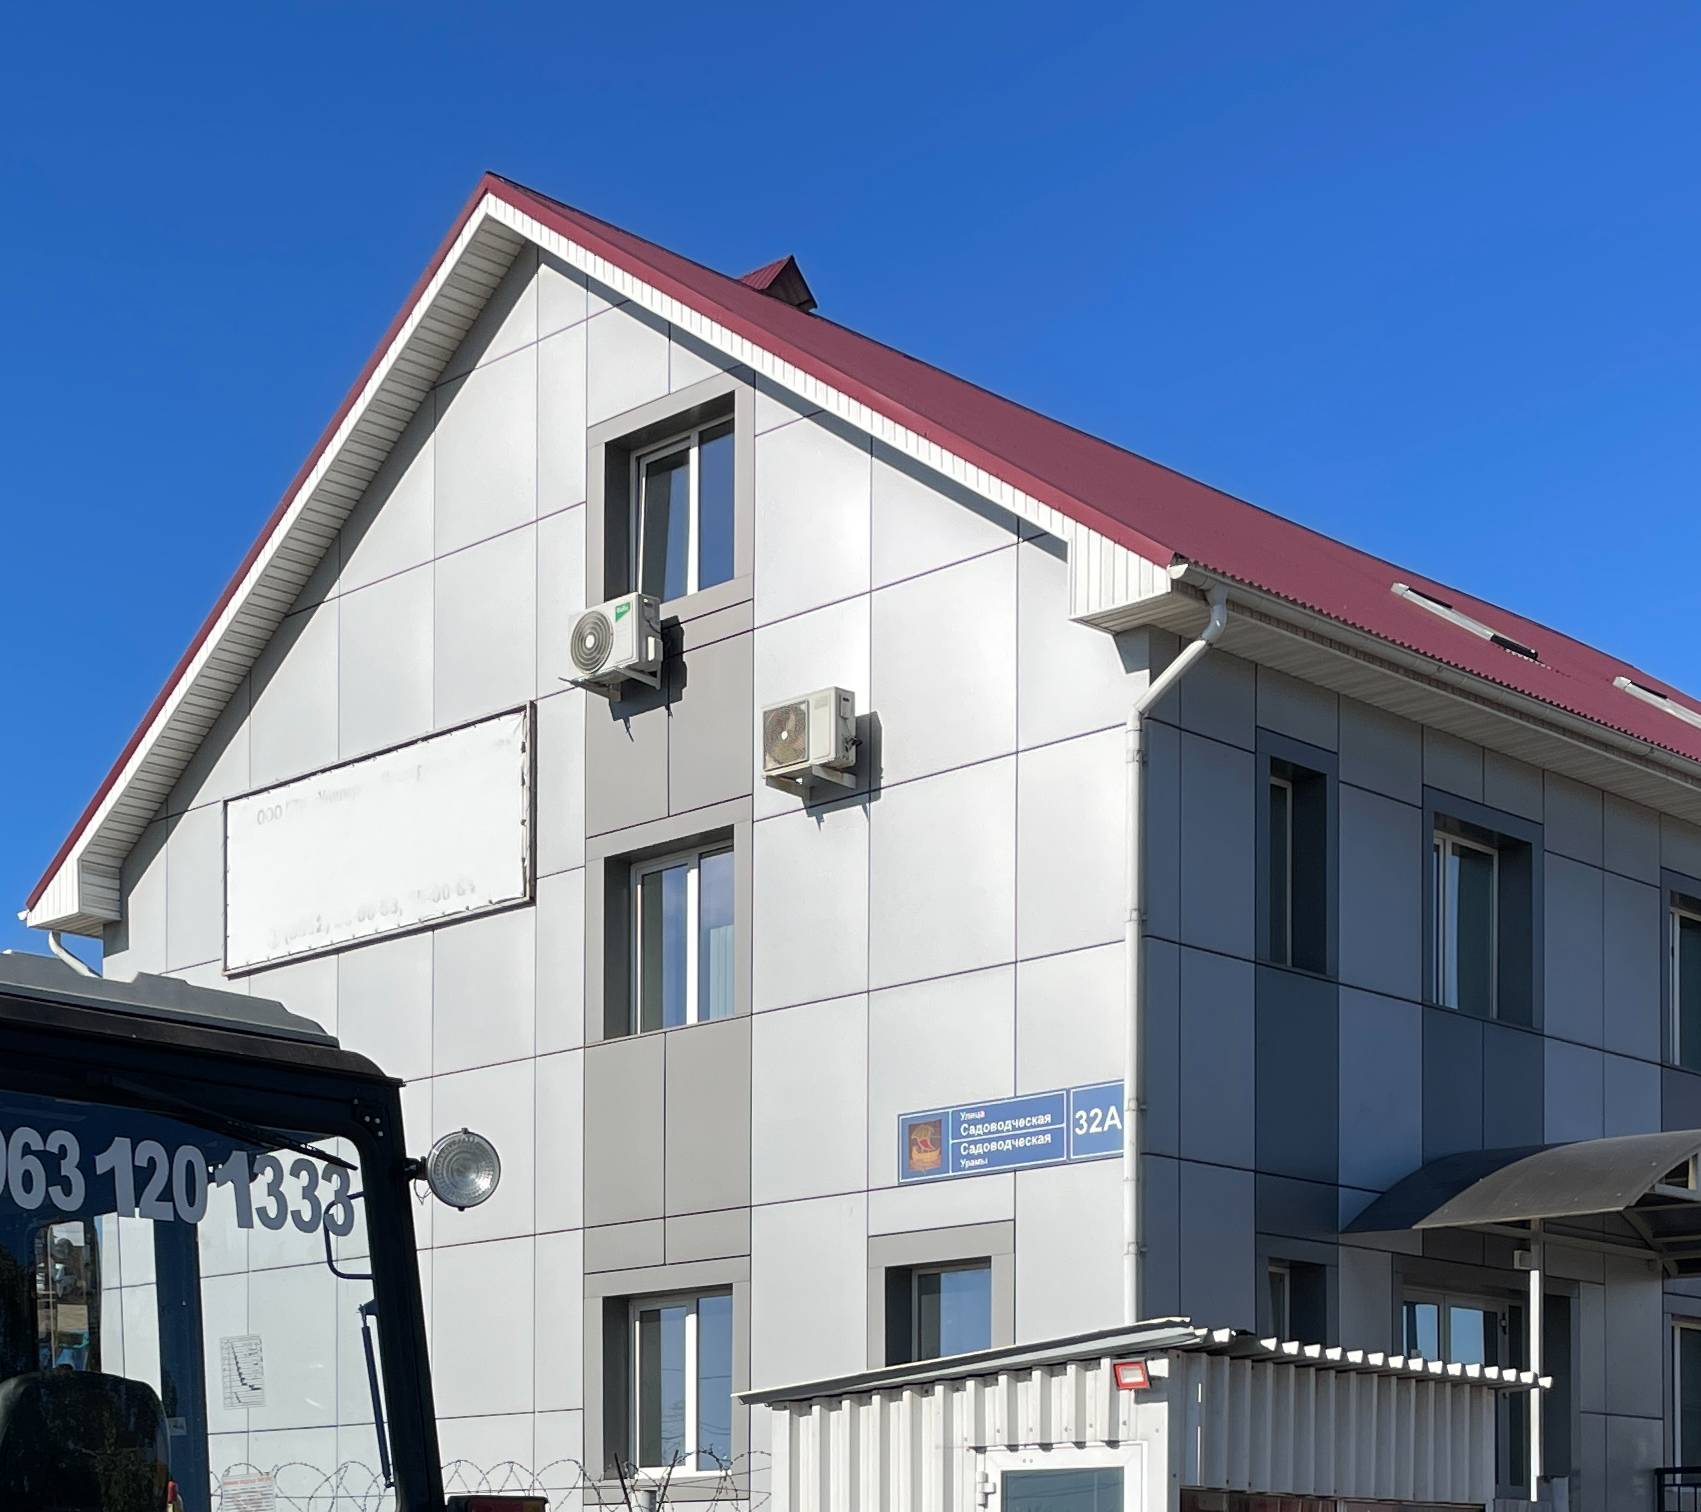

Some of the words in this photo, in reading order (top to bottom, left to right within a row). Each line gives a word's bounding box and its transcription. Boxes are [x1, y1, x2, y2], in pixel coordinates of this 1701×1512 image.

[960, 1110, 986, 1121] Улица
[960, 1113, 1052, 1136] Садоводческая
[1074, 1105, 1123, 1136] 32А
[960, 1133, 1052, 1156] Садоводческая
[95, 1136, 209, 1225] 120
[214, 1150, 355, 1237] 1333
